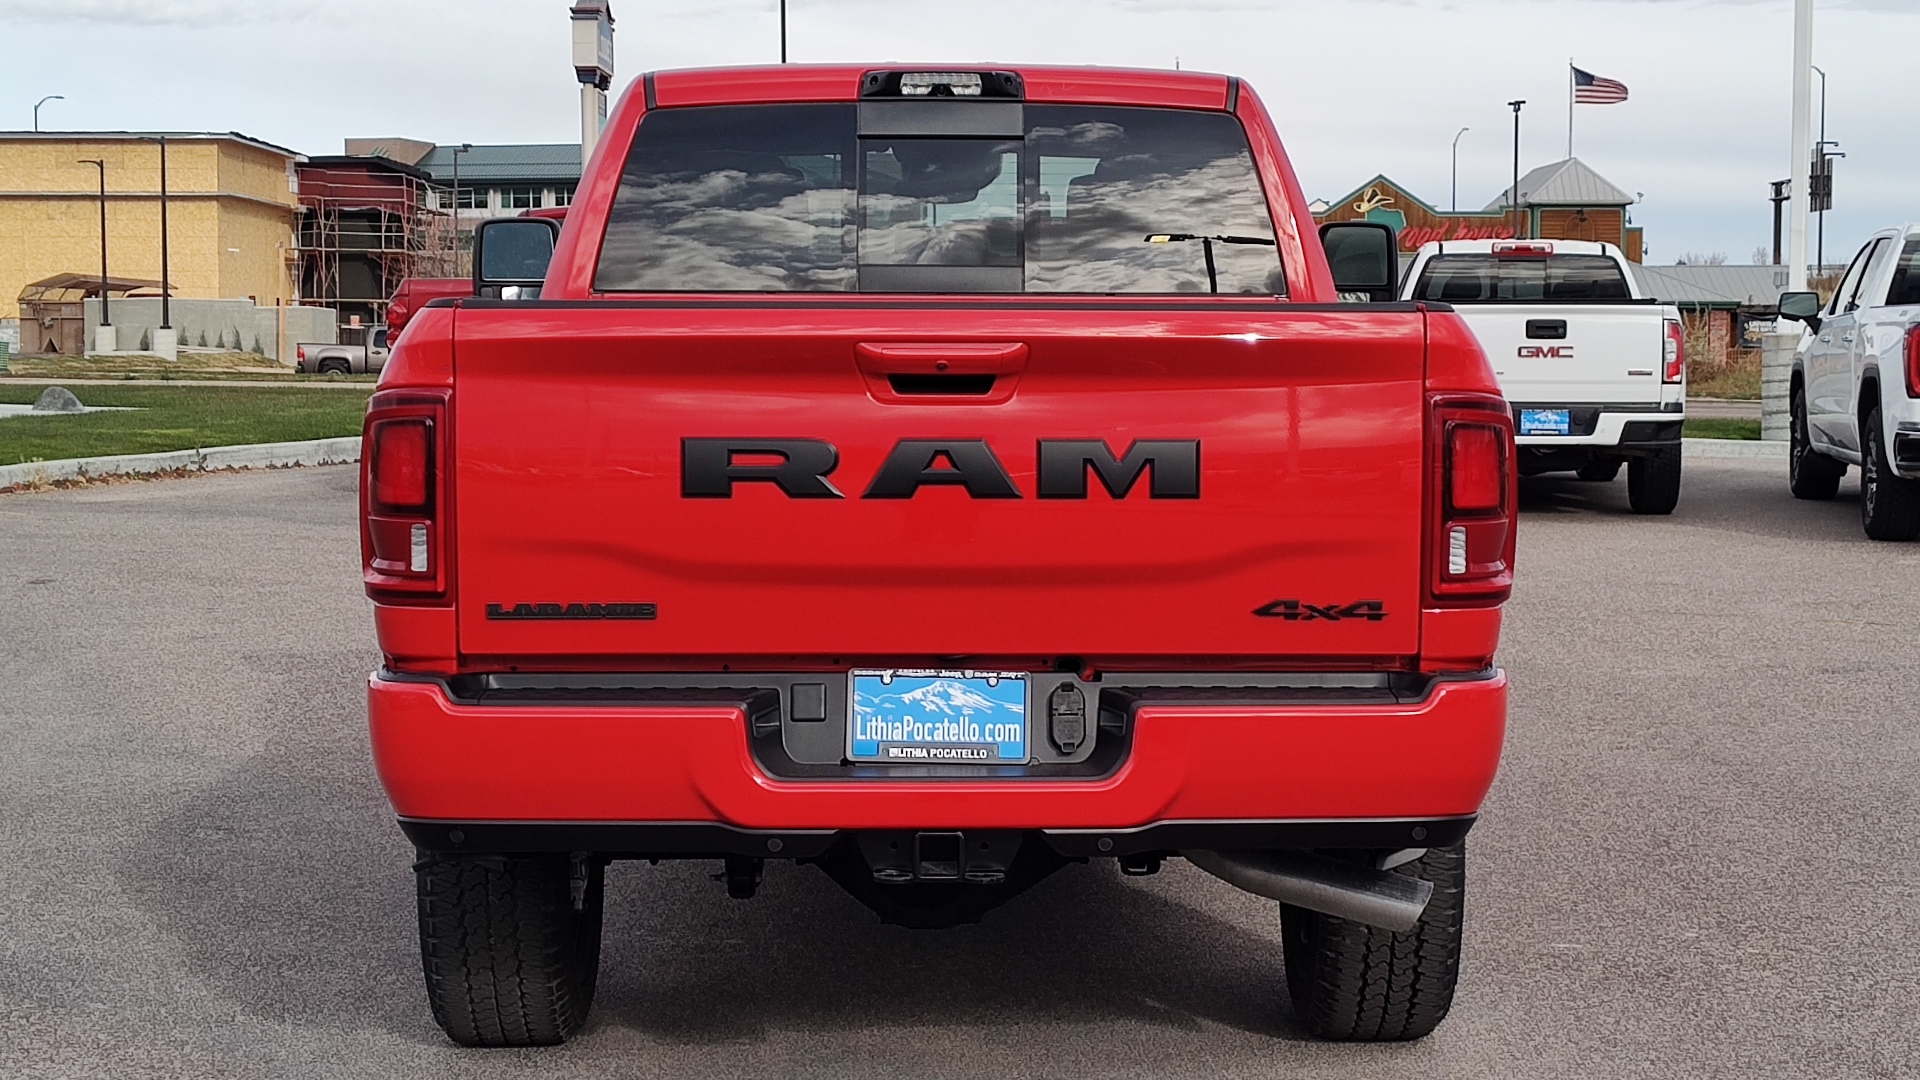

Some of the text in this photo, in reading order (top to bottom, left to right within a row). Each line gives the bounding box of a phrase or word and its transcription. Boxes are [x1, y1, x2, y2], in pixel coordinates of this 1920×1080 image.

[1518, 346, 1574, 358] GMC
[680, 437, 1201, 499] RAM
[486, 602, 658, 620] LARAMIE
[1251, 599, 1391, 621] 4x4
[857, 714, 1021, 742] LithiaPocatello.com
[897, 748, 988, 759] LITHIA POCATELLO
